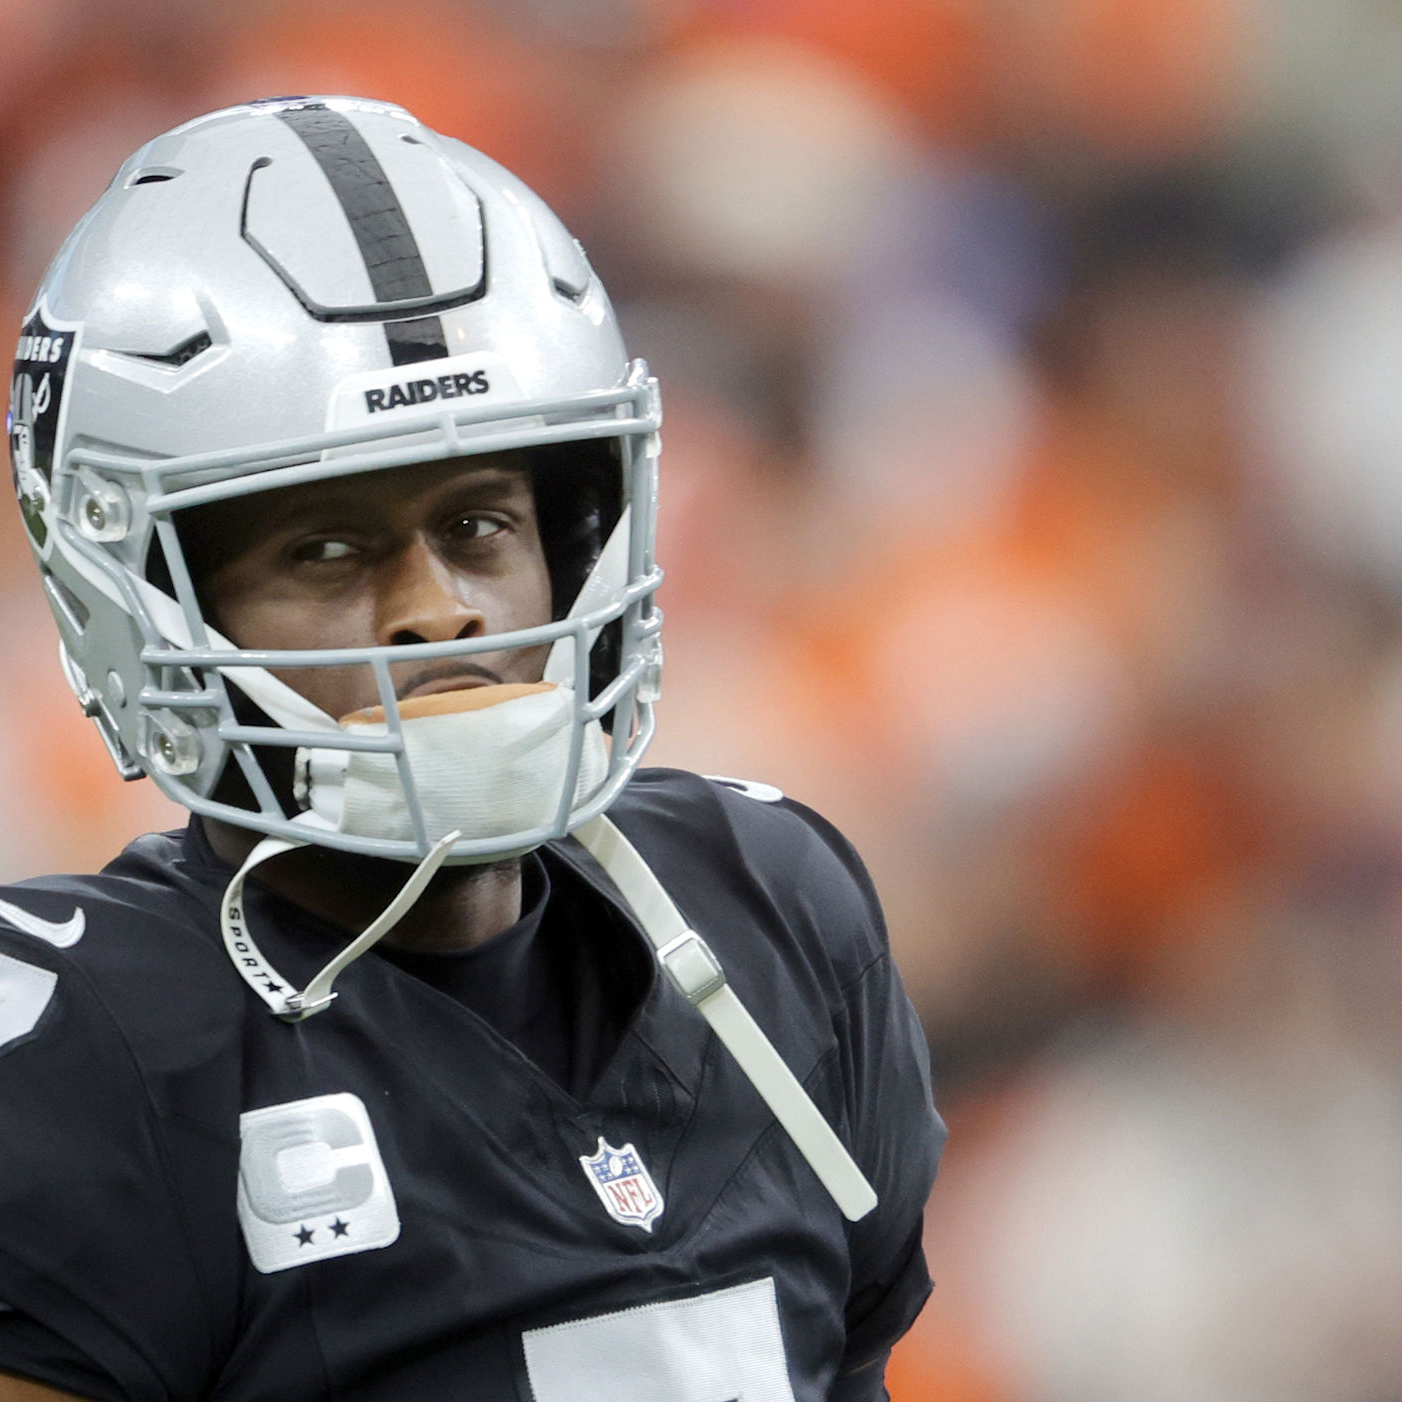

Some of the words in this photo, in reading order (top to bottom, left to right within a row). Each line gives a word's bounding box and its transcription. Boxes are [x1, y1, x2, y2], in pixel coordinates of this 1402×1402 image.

[365, 370, 489, 413] RAIDERS
[229, 906, 270, 981] SPORT
[241, 1108, 374, 1226] C
[608, 1178, 653, 1213] NFL
